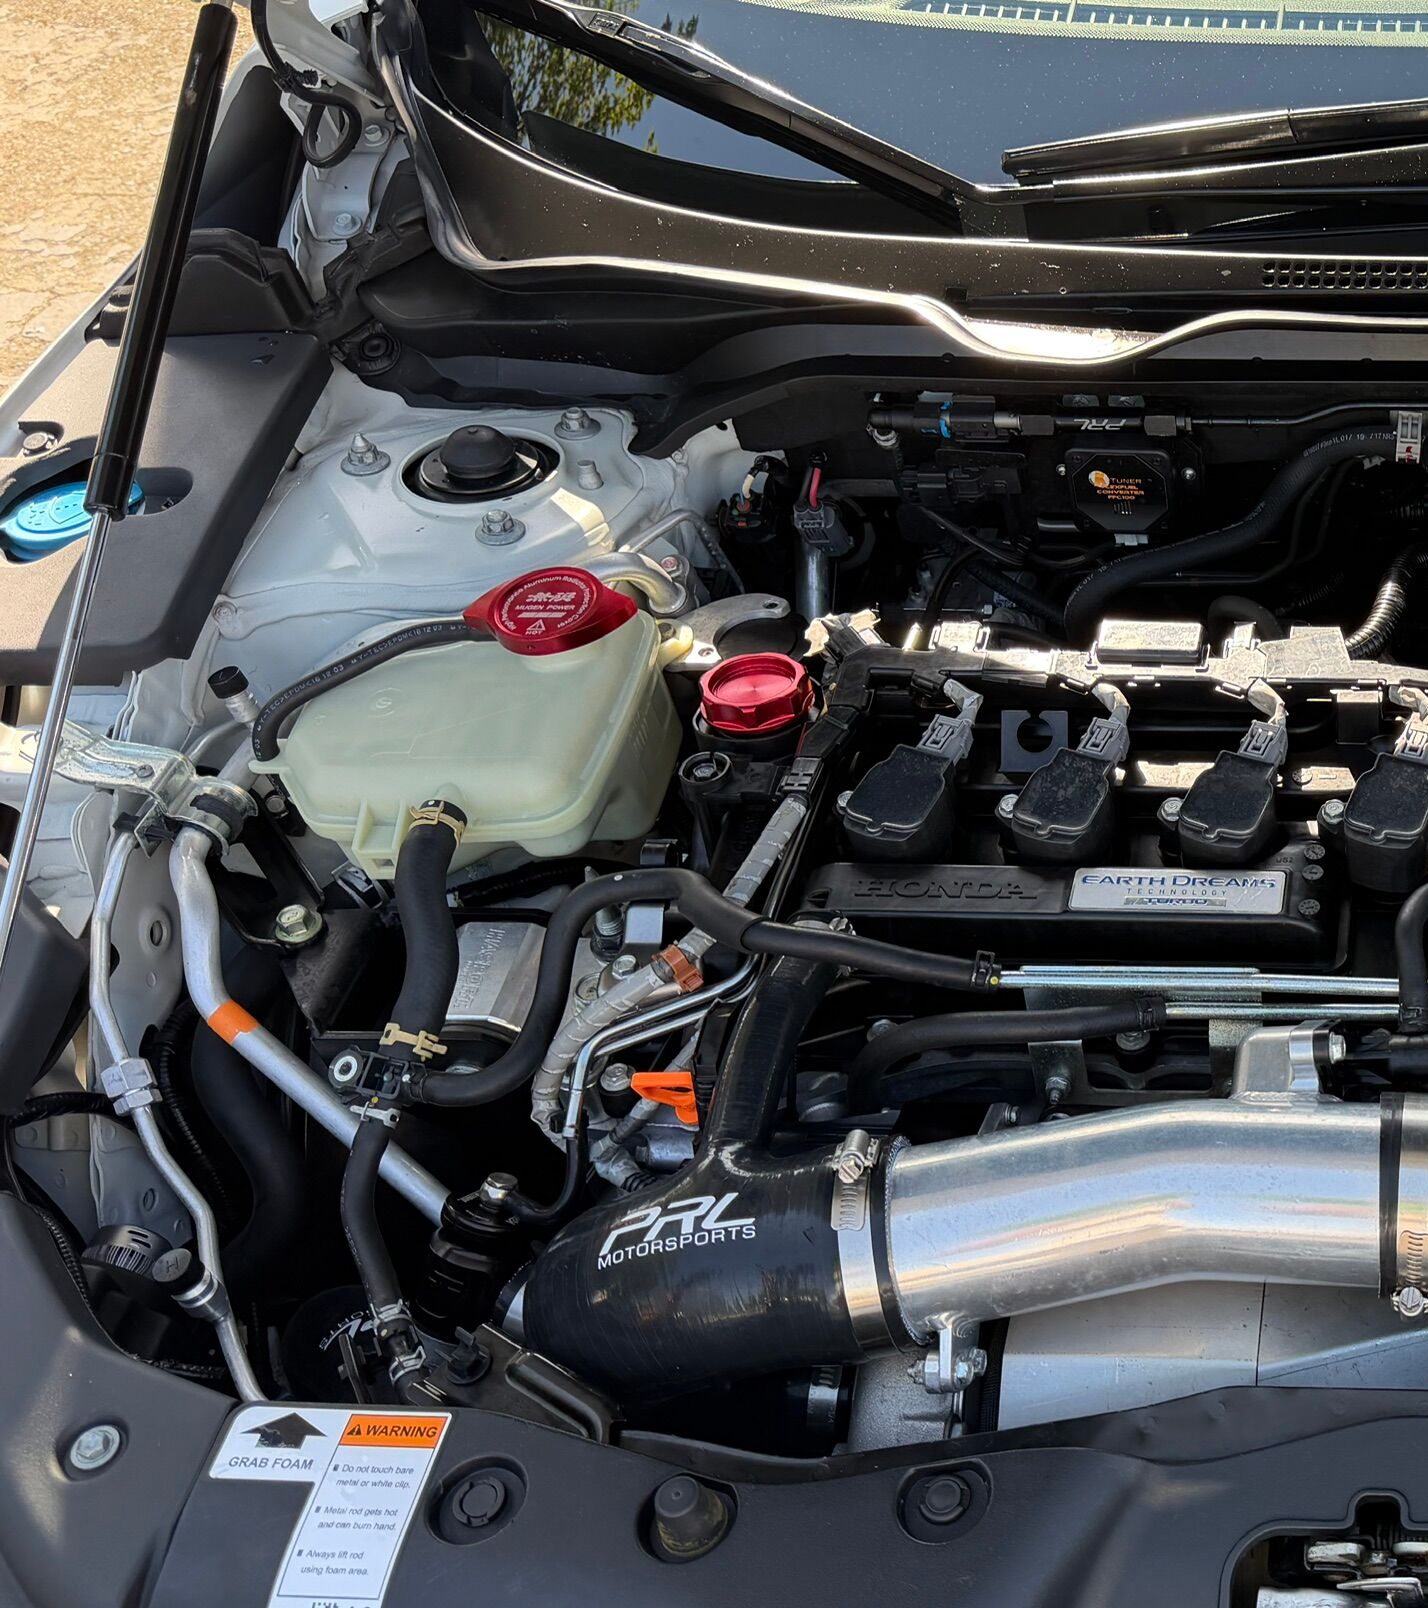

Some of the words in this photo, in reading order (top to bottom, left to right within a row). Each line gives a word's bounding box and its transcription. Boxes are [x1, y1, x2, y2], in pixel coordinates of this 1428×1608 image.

[1082, 875, 1166, 886] EARTH
[1172, 875, 1276, 888] DREAMS
[854, 881, 1038, 899] HONDA
[1127, 888, 1228, 896] TECHNOLOGY
[1144, 897, 1208, 905] TURBO
[598, 1192, 756, 1257] PRL
[597, 1225, 757, 1270] MOTORSPORTS
[365, 1424, 438, 1438] WARNING
[228, 1456, 269, 1469] GRAB
[271, 1458, 314, 1470] FOAM
[342, 1464, 354, 1473] Do
[356, 1465, 370, 1473] not
[371, 1465, 393, 1474] touch
[395, 1466, 414, 1475] bare
[335, 1478, 359, 1487] metal
[371, 1479, 393, 1488] white
[324, 1506, 346, 1514] Metal
[349, 1507, 363, 1515] rod
[364, 1508, 383, 1517] gets
[384, 1508, 398, 1517] hot
[317, 1520, 334, 1529] and
[352, 1521, 372, 1530] burn
[305, 1550, 336, 1561] Always
[337, 1551, 348, 1560] lift
[349, 1551, 364, 1560] rod
[300, 1566, 323, 1576] using
[325, 1566, 347, 1575] foam
